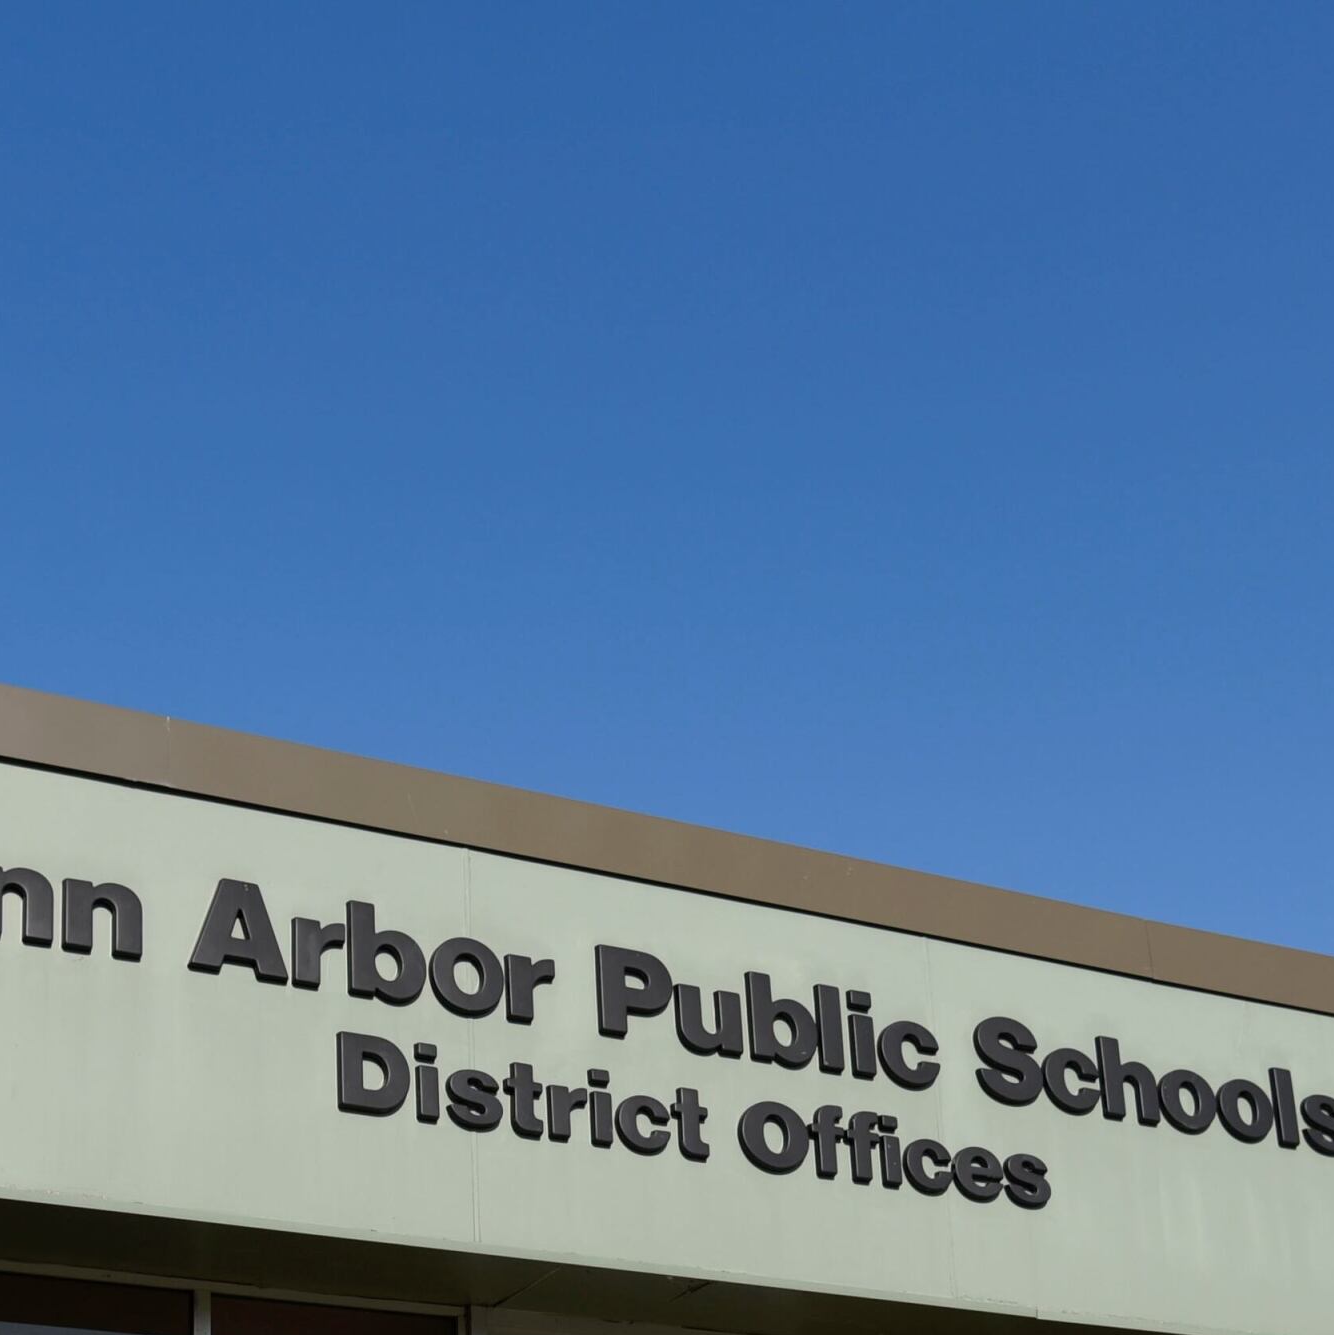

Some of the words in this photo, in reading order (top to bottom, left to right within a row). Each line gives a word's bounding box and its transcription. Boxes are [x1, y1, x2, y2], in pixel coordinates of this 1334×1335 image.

[187, 877, 556, 1025] Arbor
[594, 943, 941, 1091] Public
[336, 1031, 711, 1163] District
[738, 1100, 1052, 1210] Offices
